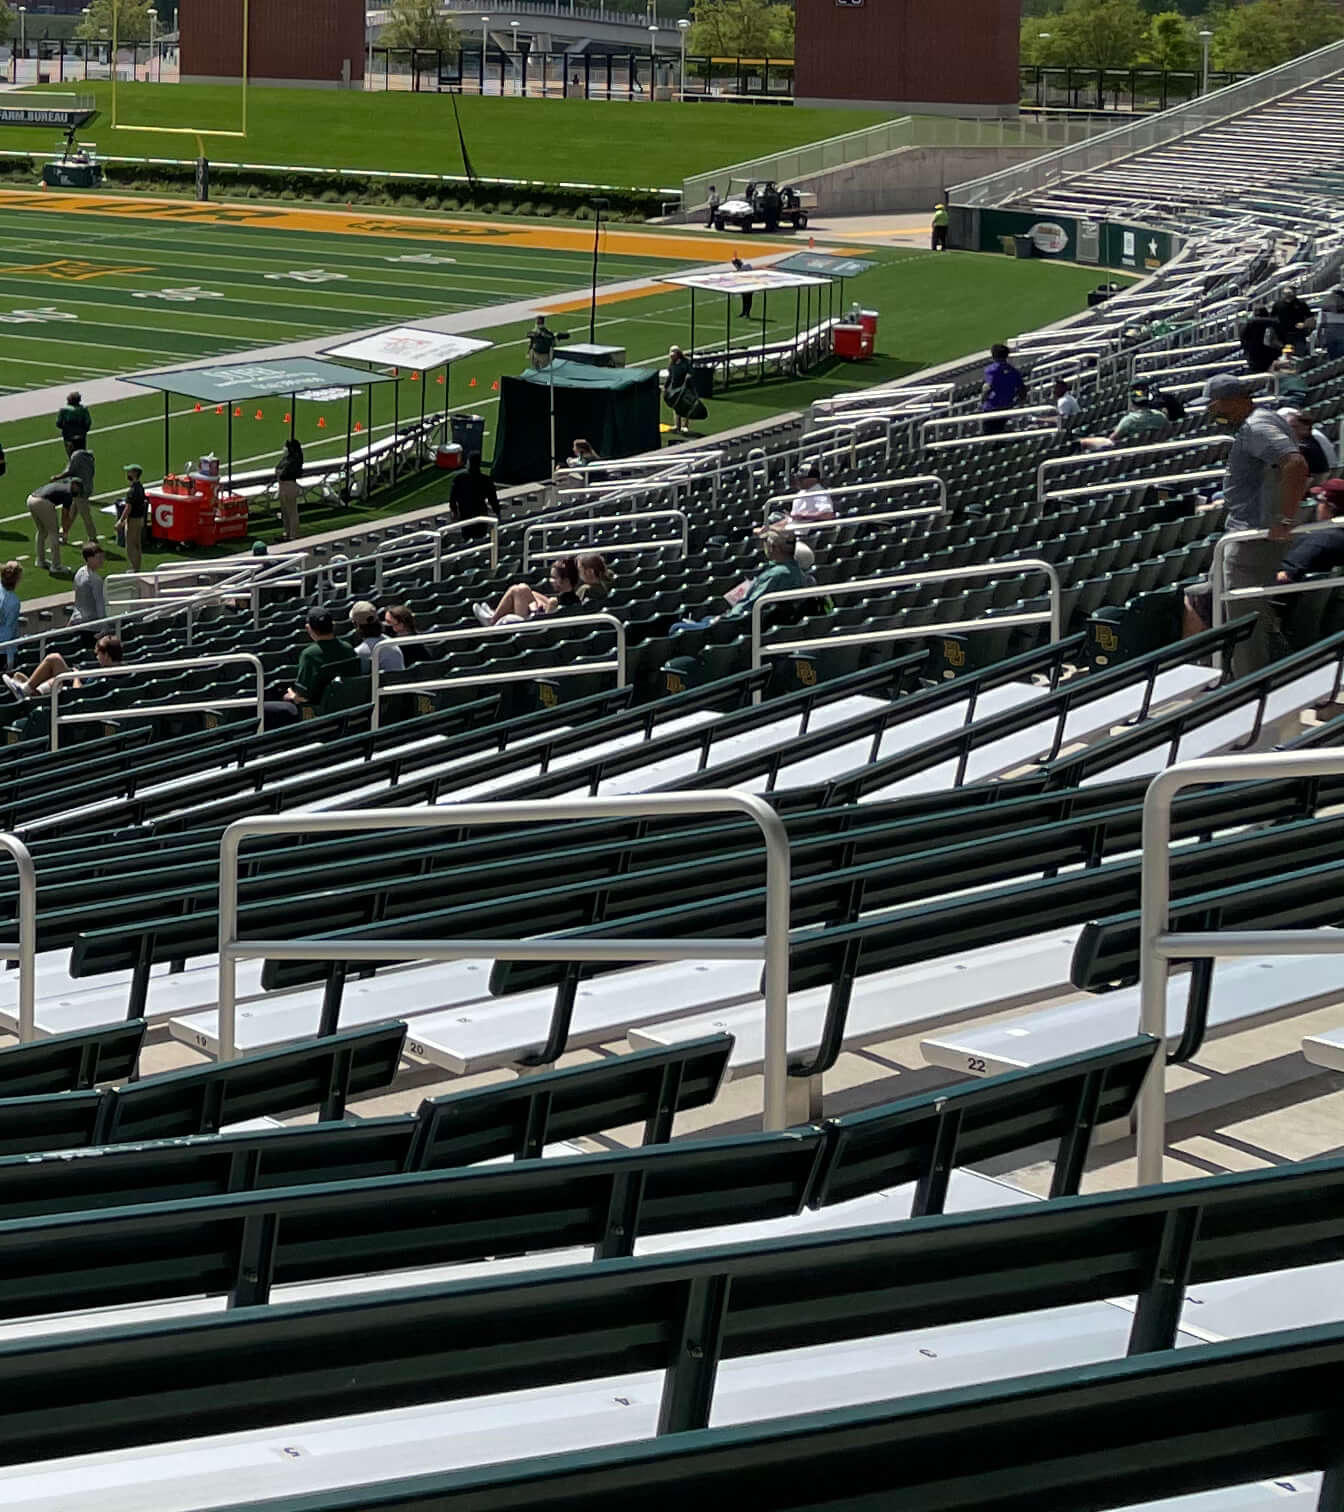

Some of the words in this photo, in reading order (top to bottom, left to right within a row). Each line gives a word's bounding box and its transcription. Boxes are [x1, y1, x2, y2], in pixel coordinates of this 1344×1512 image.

[154, 503, 174, 528] G
[409, 1041, 424, 1055] 20
[967, 1057, 986, 1073] 22
